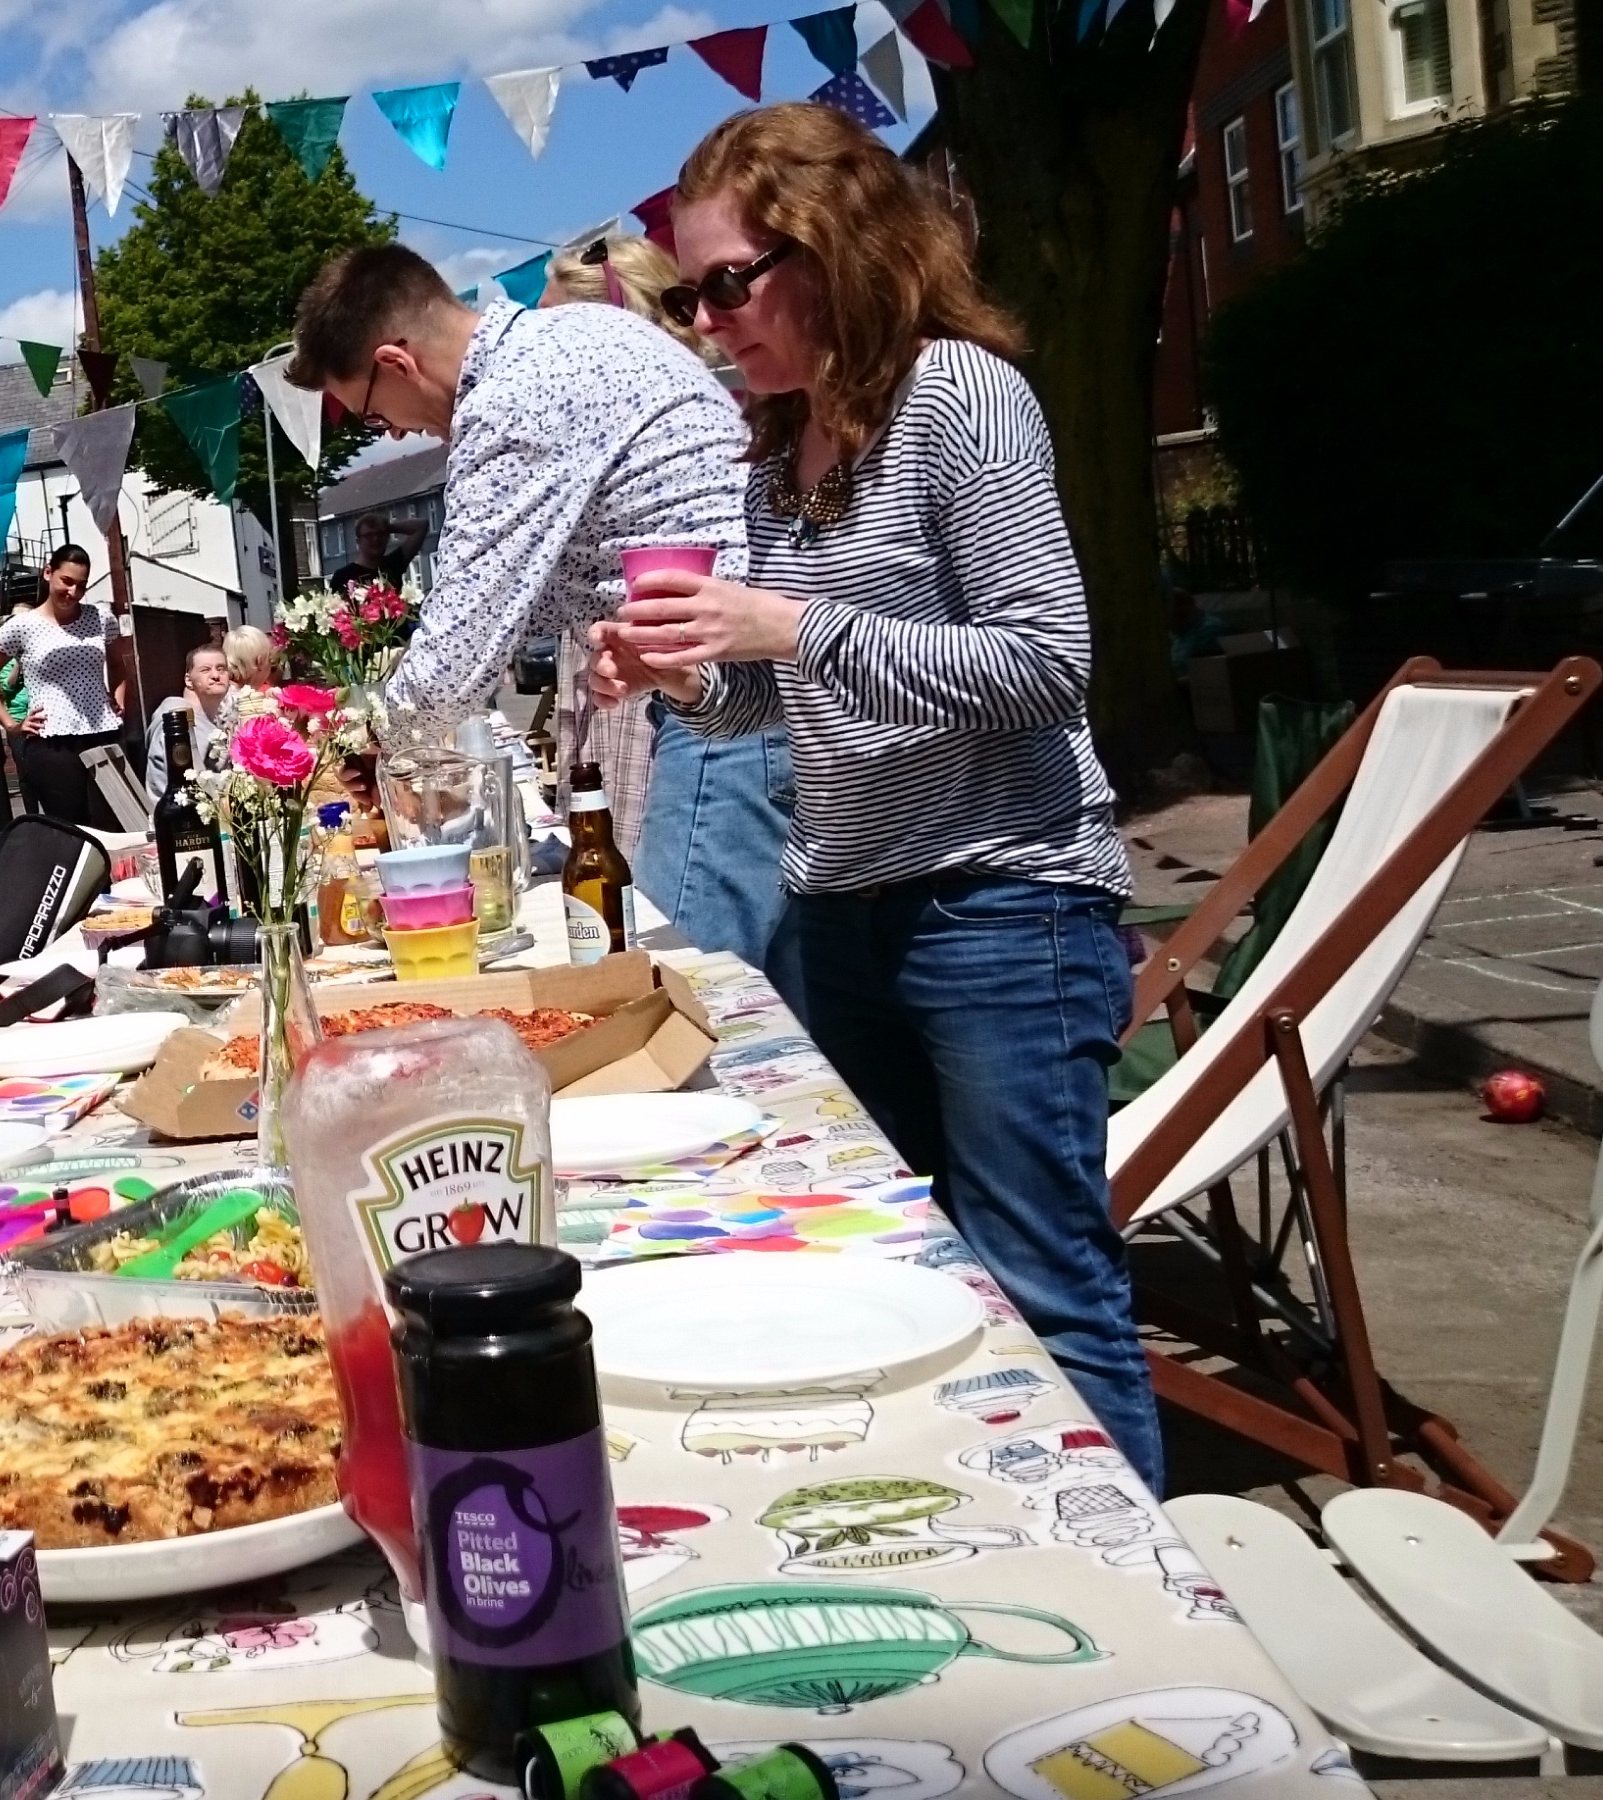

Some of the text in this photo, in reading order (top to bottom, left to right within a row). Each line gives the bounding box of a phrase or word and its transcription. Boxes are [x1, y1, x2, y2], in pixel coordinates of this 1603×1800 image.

[399, 1139, 504, 1192] HEINZ
[444, 1180, 472, 1196] 1869
[455, 1511, 495, 1526] TESCO
[457, 1530, 518, 1551] Pitted
[460, 1551, 521, 1574] Black
[463, 1574, 531, 1597] Olives
[466, 1595, 505, 1609] in brine
